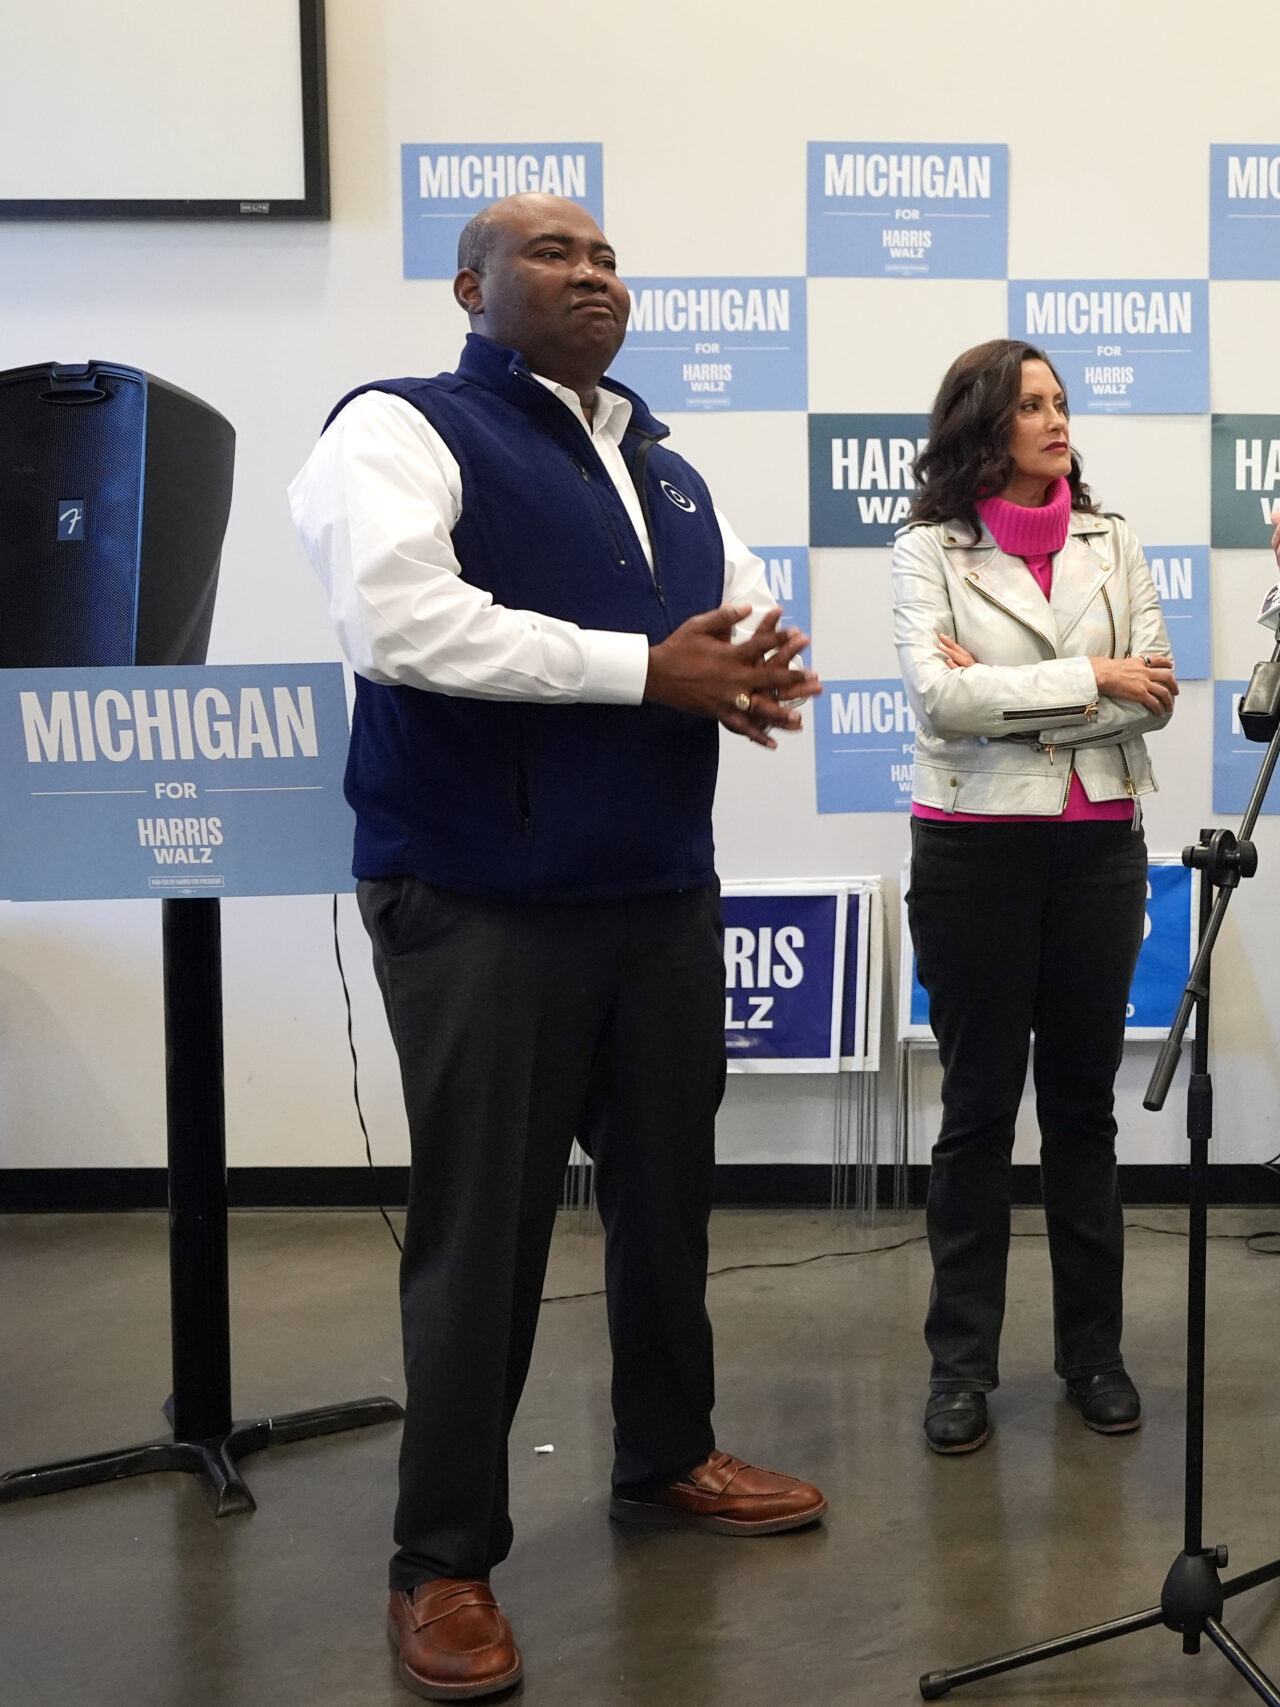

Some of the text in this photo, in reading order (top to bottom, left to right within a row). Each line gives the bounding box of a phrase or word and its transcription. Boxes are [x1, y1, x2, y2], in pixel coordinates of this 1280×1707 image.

[419, 155, 586, 198] MICHIGAN
[825, 154, 990, 198] MICHIGAN
[895, 209, 920, 220] FOR
[883, 230, 931, 248] HARRIS
[890, 248, 924, 258] WALZ
[626, 289, 789, 331] MICHIGAN
[1027, 292, 1191, 334] MICHIGAN
[695, 343, 719, 353] FOR
[1097, 346, 1121, 356] FOR
[683, 364, 732, 381] HARRIS
[1085, 366, 1133, 384] HARRIS
[691, 382, 724, 392] WALZ
[1093, 384, 1126, 395] WALZ
[831, 438, 928, 490] HAR
[857, 496, 912, 524] WA
[831, 691, 916, 734] MICH
[20, 687, 318, 762] MICHIGAN
[155, 783, 197, 798] FOR
[138, 817, 223, 846] HARRIS
[154, 848, 212, 864] WALZ
[724, 926, 805, 988] RIS
[725, 996, 774, 1029] LZ
